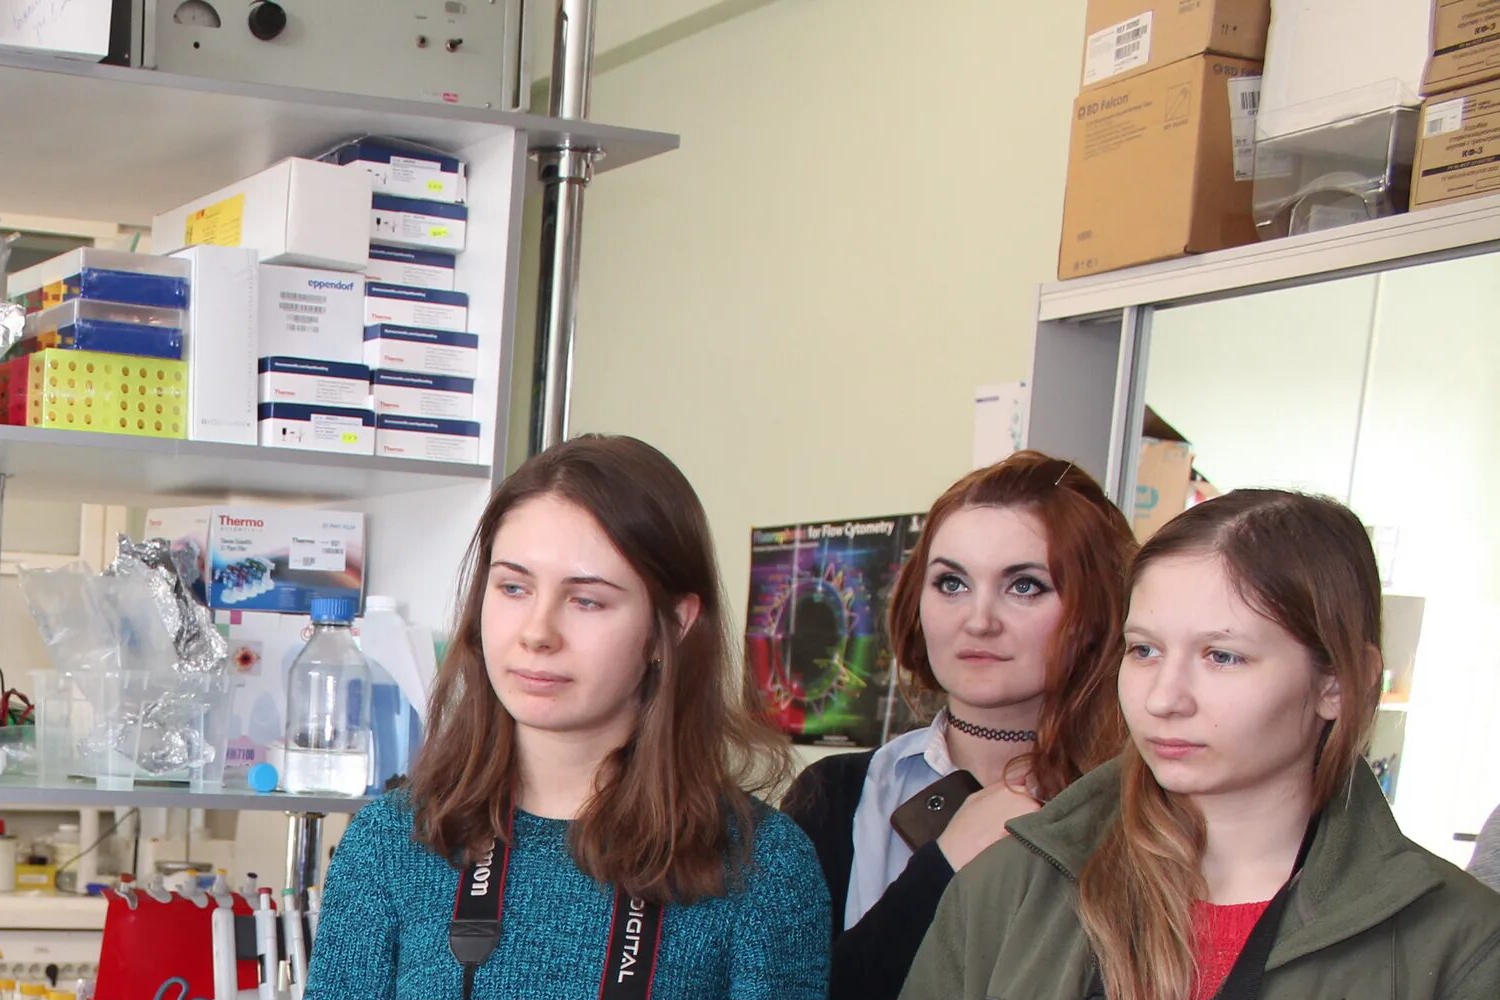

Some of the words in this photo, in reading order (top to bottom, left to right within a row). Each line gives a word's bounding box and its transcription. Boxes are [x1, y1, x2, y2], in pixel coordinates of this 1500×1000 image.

[1086, 102, 1100, 116] BD
[1100, 94, 1129, 111] Falcon
[308, 278, 354, 292] eppendorf
[218, 514, 264, 528] Thermo
[808, 525, 822, 539] for
[822, 524, 843, 538] Flow
[844, 520, 895, 539] Cytometry
[618, 897, 644, 984] DIGITAL
